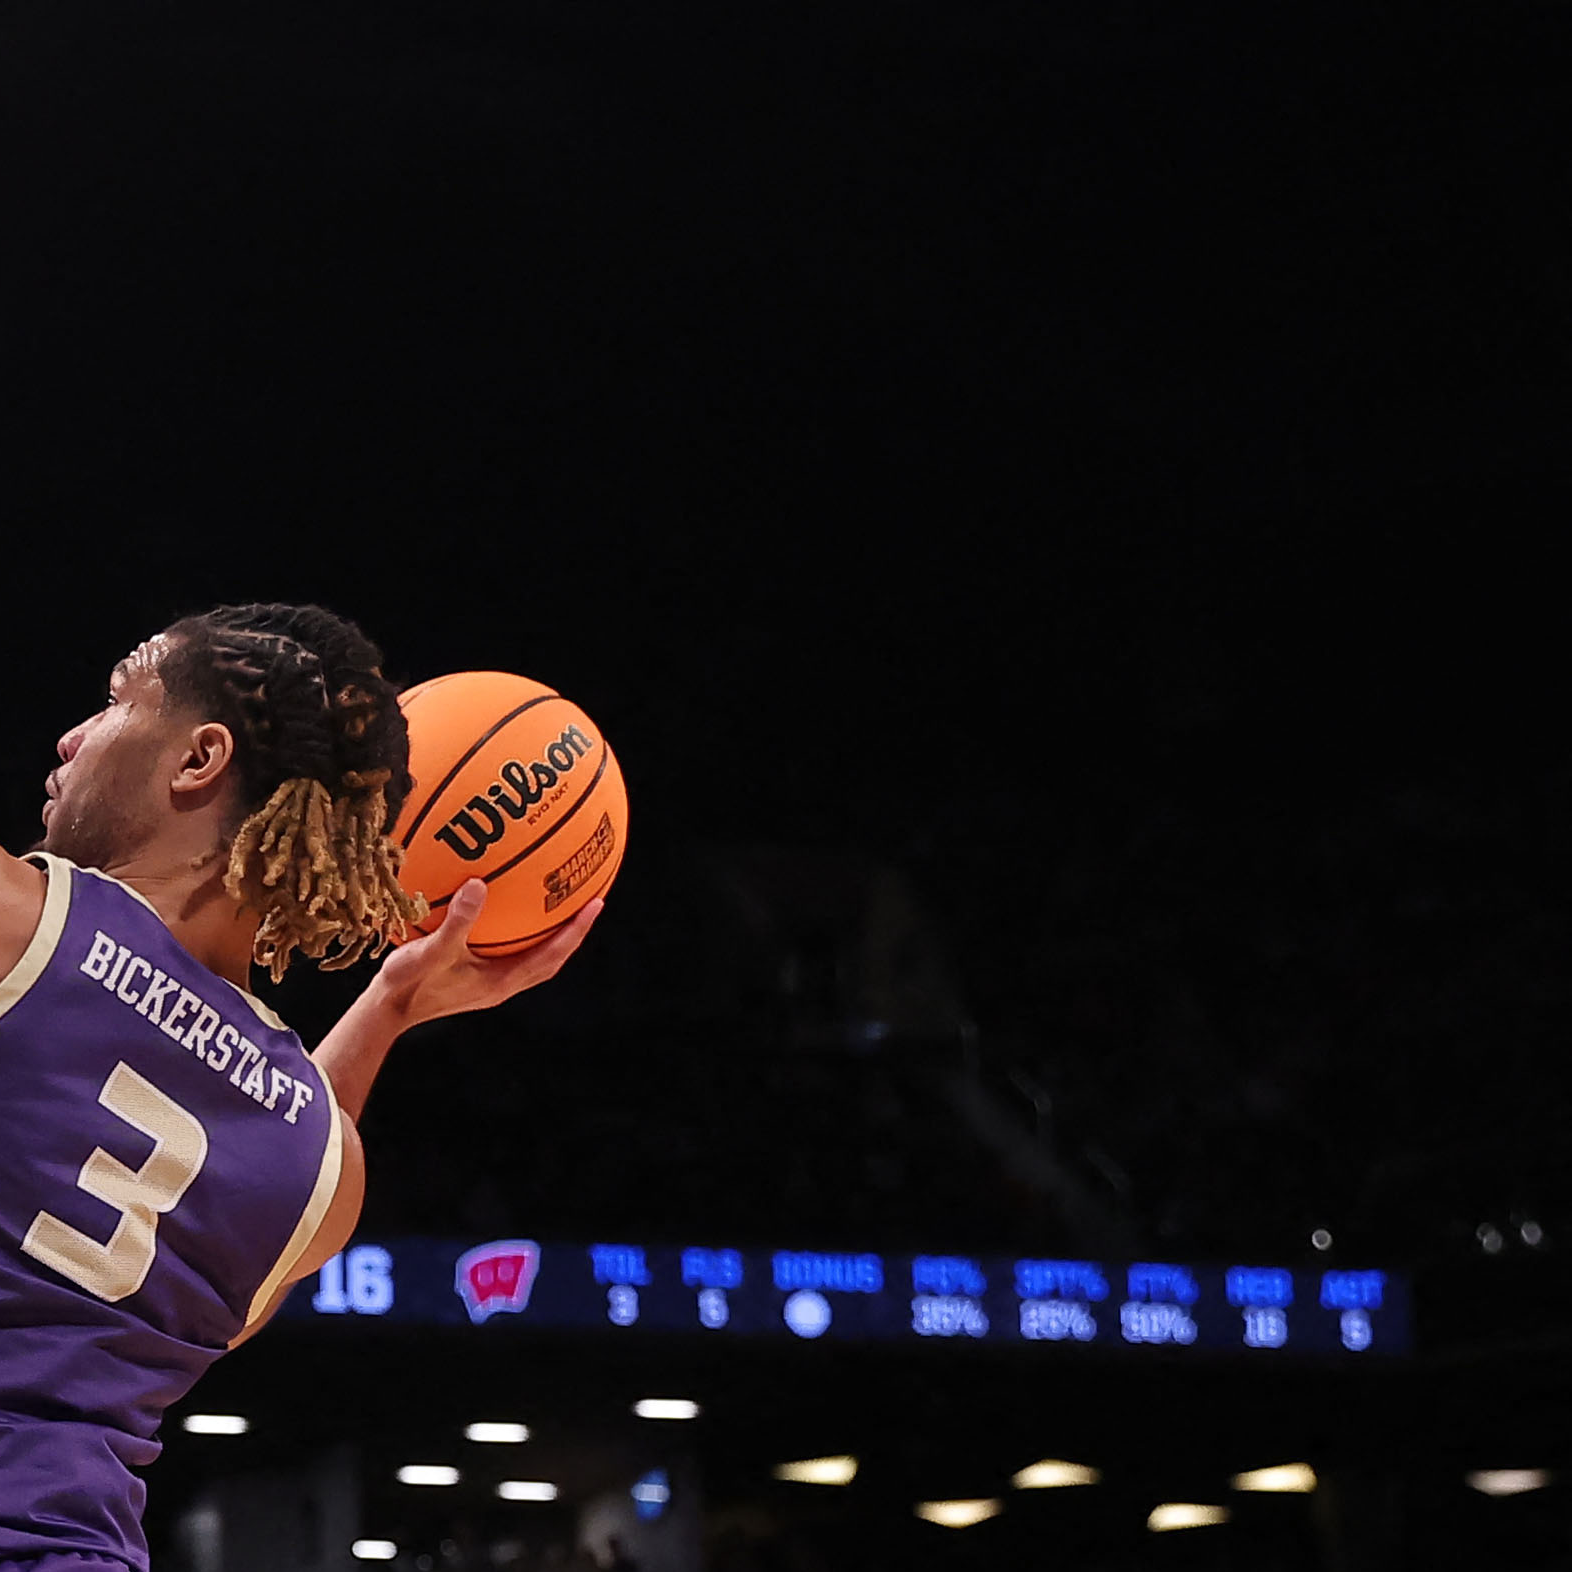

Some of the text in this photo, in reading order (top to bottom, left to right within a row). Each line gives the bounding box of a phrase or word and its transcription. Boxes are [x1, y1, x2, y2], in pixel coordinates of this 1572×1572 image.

[434, 724, 593, 862] Wilson
[527, 802, 550, 826] EVO
[79, 930, 313, 1125] BICKERSTAFF
[20, 1060, 209, 1302] 3
[312, 1244, 394, 1315] 16
